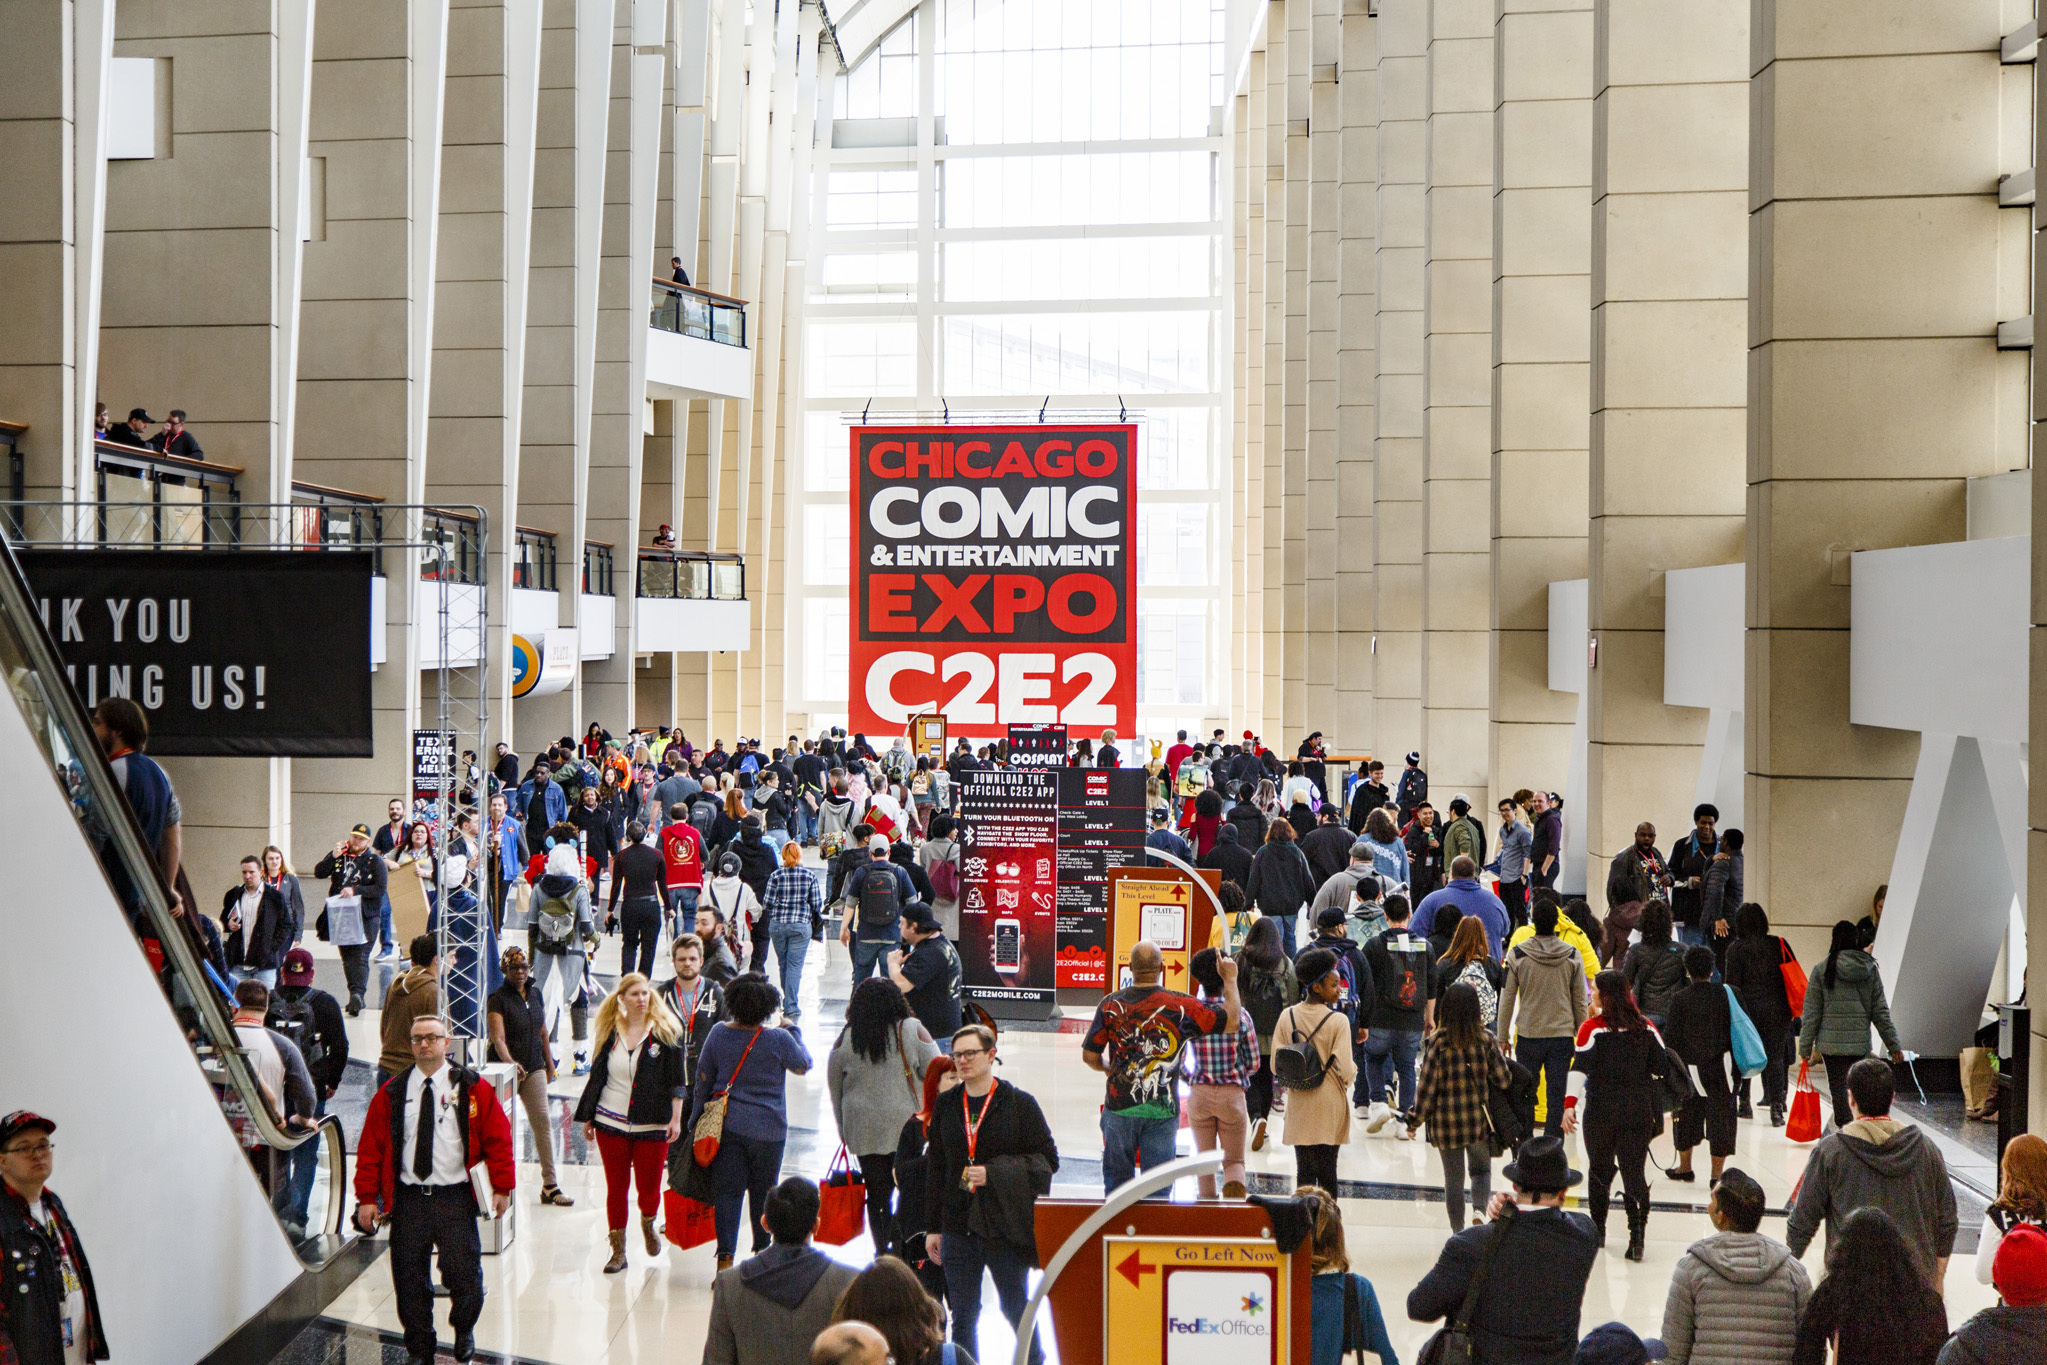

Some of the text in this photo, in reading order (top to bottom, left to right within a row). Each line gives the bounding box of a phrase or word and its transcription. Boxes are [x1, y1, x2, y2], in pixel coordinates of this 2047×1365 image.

[868, 440, 1118, 479] CHICAGO
[869, 485, 1120, 539] COMIC
[870, 544, 1120, 567] & ENTERTAINMENT
[868, 573, 1118, 634] EXPO
[105, 598, 190, 643] YOU
[67, 665, 266, 710] ING US!
[865, 651, 1118, 726] C2E2
[1010, 753, 1065, 765] COSPLAY
[963, 784, 1055, 797] OFFICIAL C2E2 APP
[973, 773, 1045, 785] DOWNLOAD THE
[972, 990, 1040, 1000] C2E2MOBILE.COM
[1175, 1247, 1277, 1262] Go Left Now
[1169, 1318, 1265, 1336] FedEx Office
